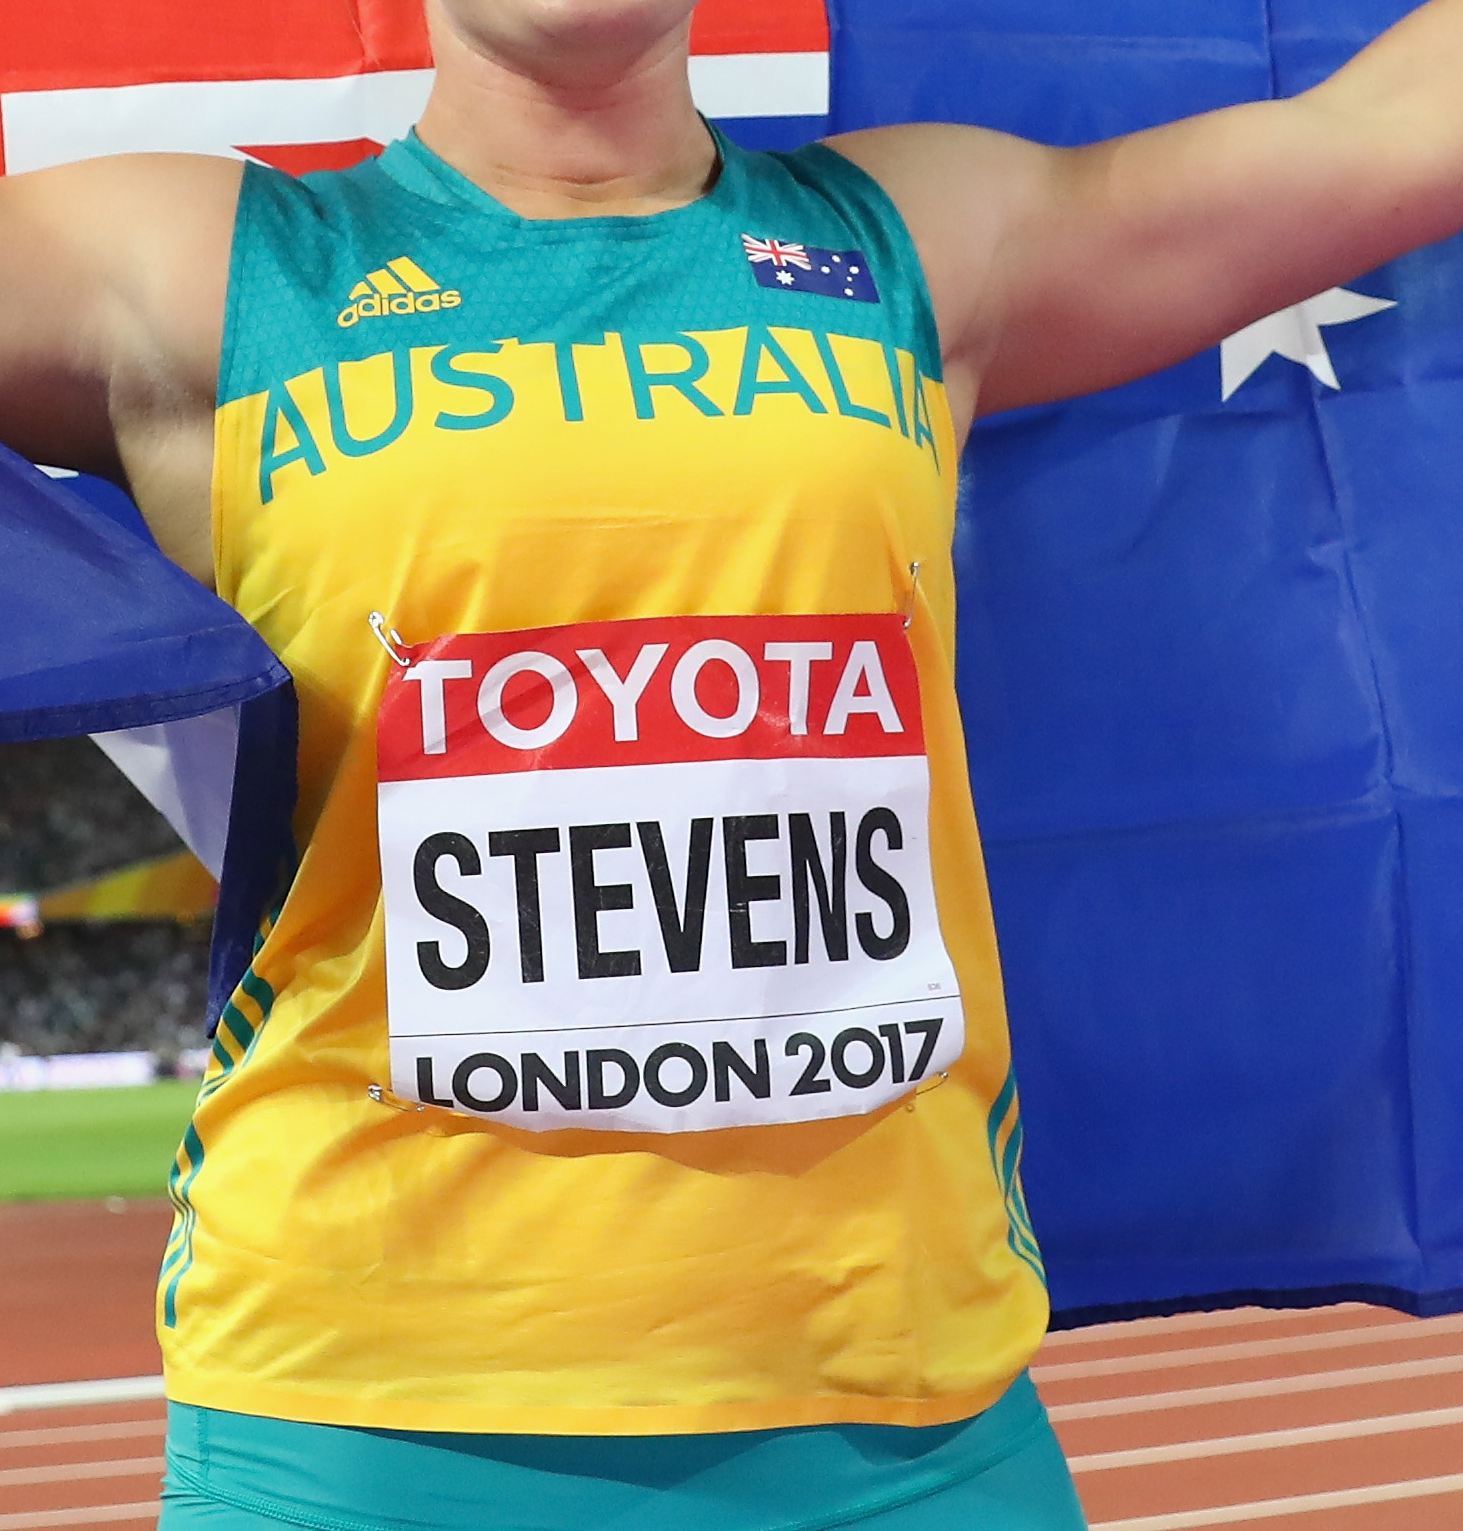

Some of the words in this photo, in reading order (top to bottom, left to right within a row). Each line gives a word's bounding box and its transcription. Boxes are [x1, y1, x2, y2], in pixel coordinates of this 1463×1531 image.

[337, 290, 462, 328] adidas
[258, 326, 941, 505] AUSTRALIA
[403, 639, 904, 755] TOYOTA
[412, 807, 911, 991] STEVENS
[416, 1038, 770, 1113] LONDON
[785, 1018, 943, 1097] 2017
